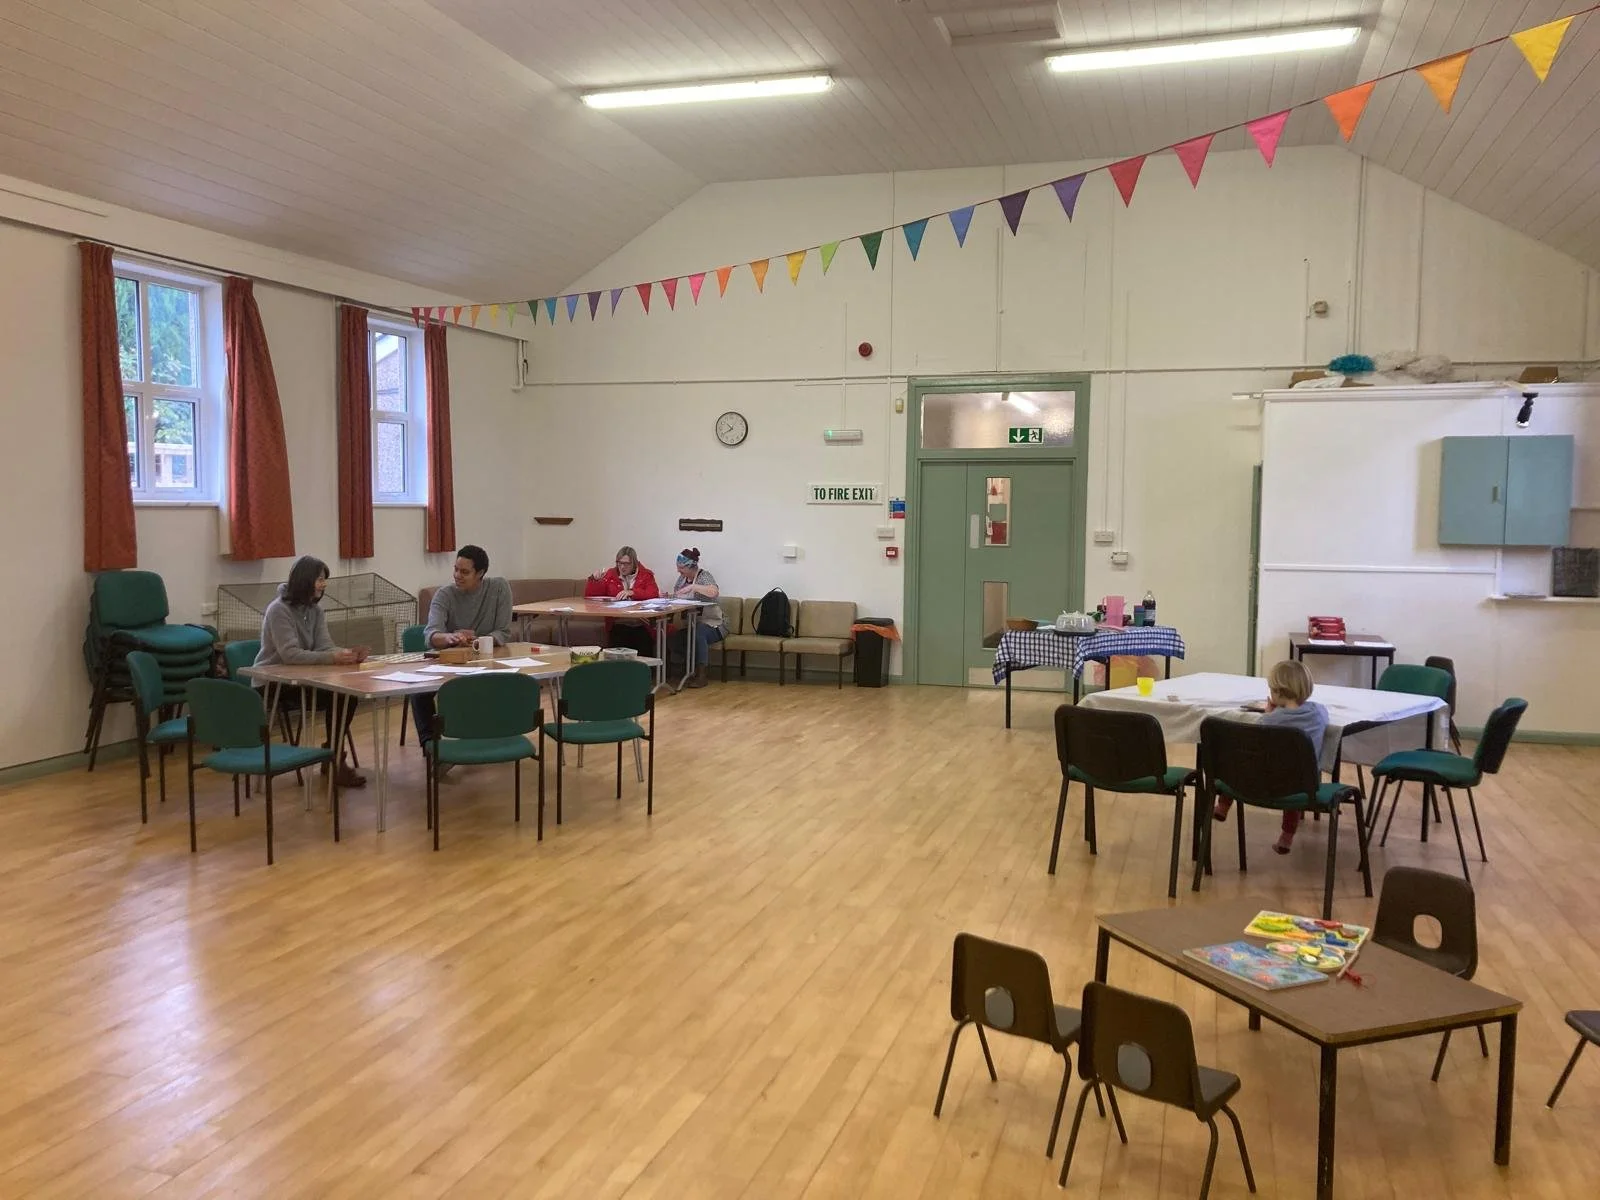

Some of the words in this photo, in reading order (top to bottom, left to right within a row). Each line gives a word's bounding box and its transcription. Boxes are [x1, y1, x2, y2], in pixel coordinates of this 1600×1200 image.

[814, 487, 826, 500] TO
[828, 487, 850, 500] FIRE
[852, 487, 874, 500] EXIT
